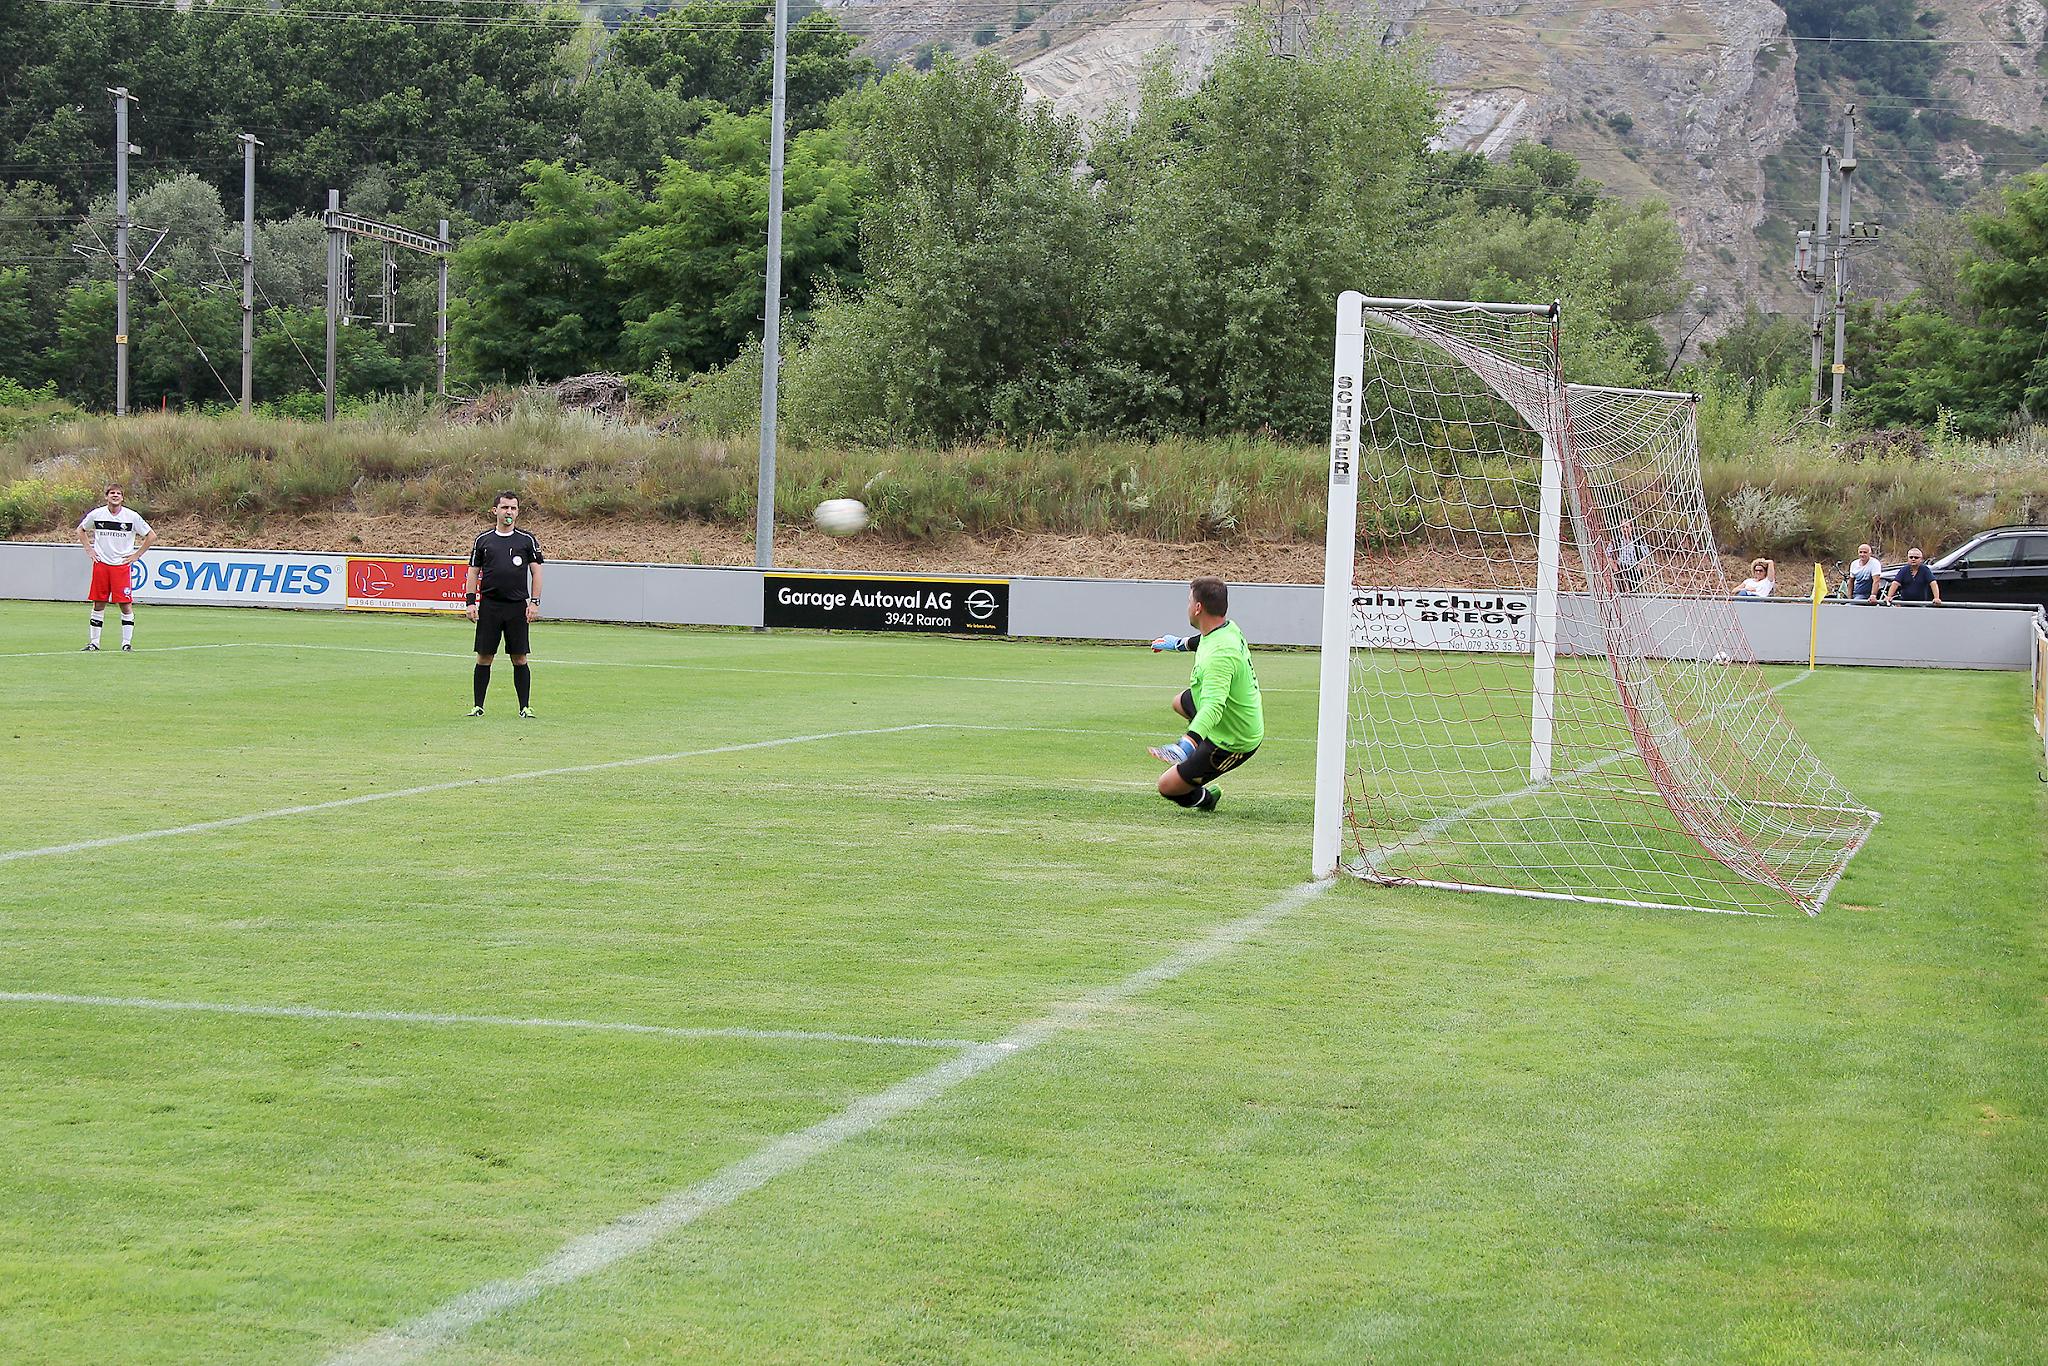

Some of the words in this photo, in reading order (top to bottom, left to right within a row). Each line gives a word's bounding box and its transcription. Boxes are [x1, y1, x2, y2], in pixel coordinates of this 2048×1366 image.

[154, 560, 332, 595] SYNTHES
[402, 563, 455, 582] Eggel
[777, 587, 847, 611] Garage
[850, 589, 921, 609] Autoval
[924, 592, 952, 610] AG
[1352, 593, 1527, 611] ahrschule
[885, 612, 914, 626] 3942
[917, 614, 951, 627] Raron
[1421, 611, 1525, 625] BREGY
[1467, 640, 1482, 650] 079
